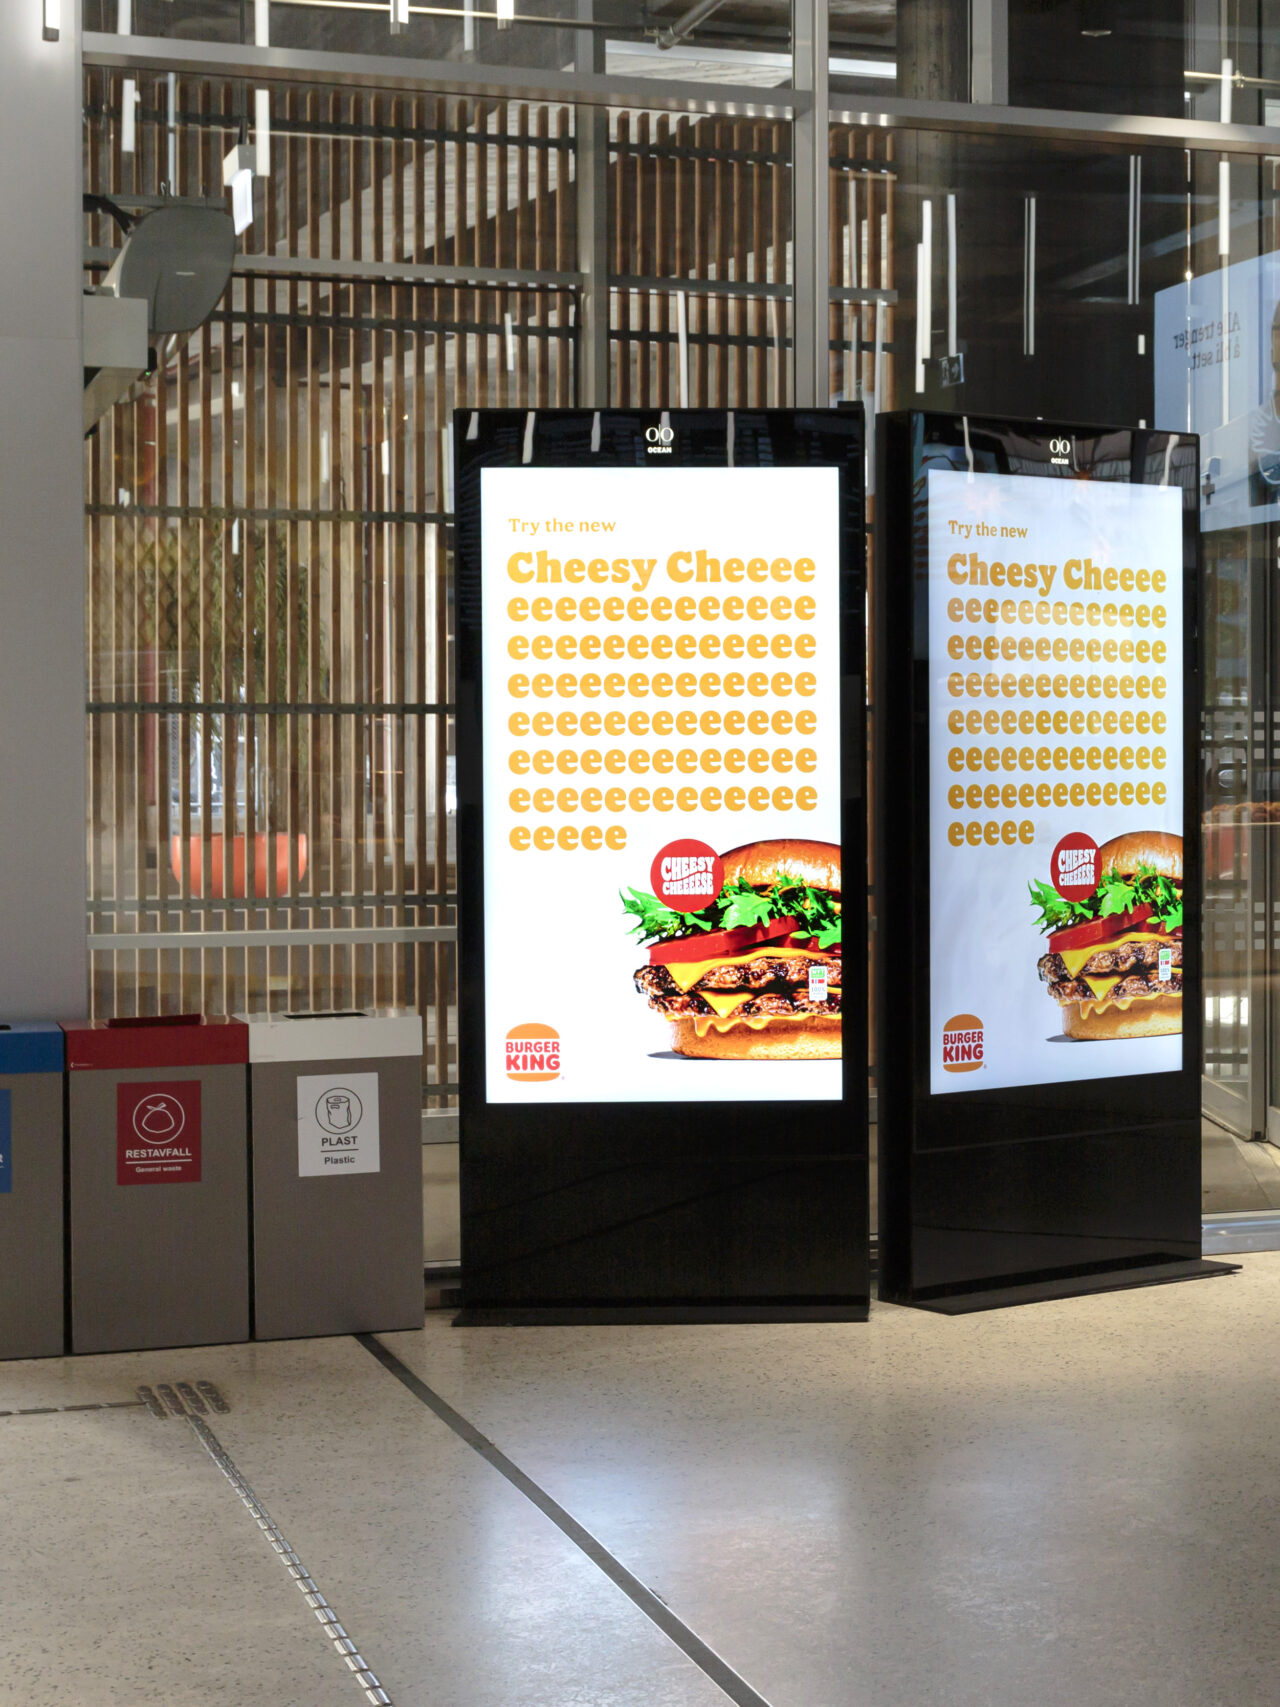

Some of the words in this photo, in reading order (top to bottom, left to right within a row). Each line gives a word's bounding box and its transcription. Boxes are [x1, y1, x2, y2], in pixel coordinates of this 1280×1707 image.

[647, 446, 672, 454] OCEAN
[508, 518, 540, 536] Try
[545, 517, 575, 533] the
[579, 521, 617, 533] new
[948, 520, 973, 539] Try
[976, 522, 998, 537] the
[1000, 525, 1028, 538] new
[507, 549, 658, 592] Cheesy
[666, 549, 817, 584] Cheeee
[947, 552, 1057, 597] Cheesy
[1063, 558, 1167, 593] Cheeee
[509, 825, 628, 851] eeeee
[947, 820, 1035, 847] eeeee
[661, 856, 716, 881] CHEESY
[1058, 849, 1096, 873] CHEESY
[505, 1041, 560, 1053] BURGER
[942, 1031, 984, 1045] BURGER
[505, 1054, 560, 1071] KING
[942, 1043, 984, 1063] KING
[321, 1136, 358, 1147] PLAST
[125, 1147, 193, 1159] RESTAVFALL
[324, 1155, 356, 1165] Plastic
